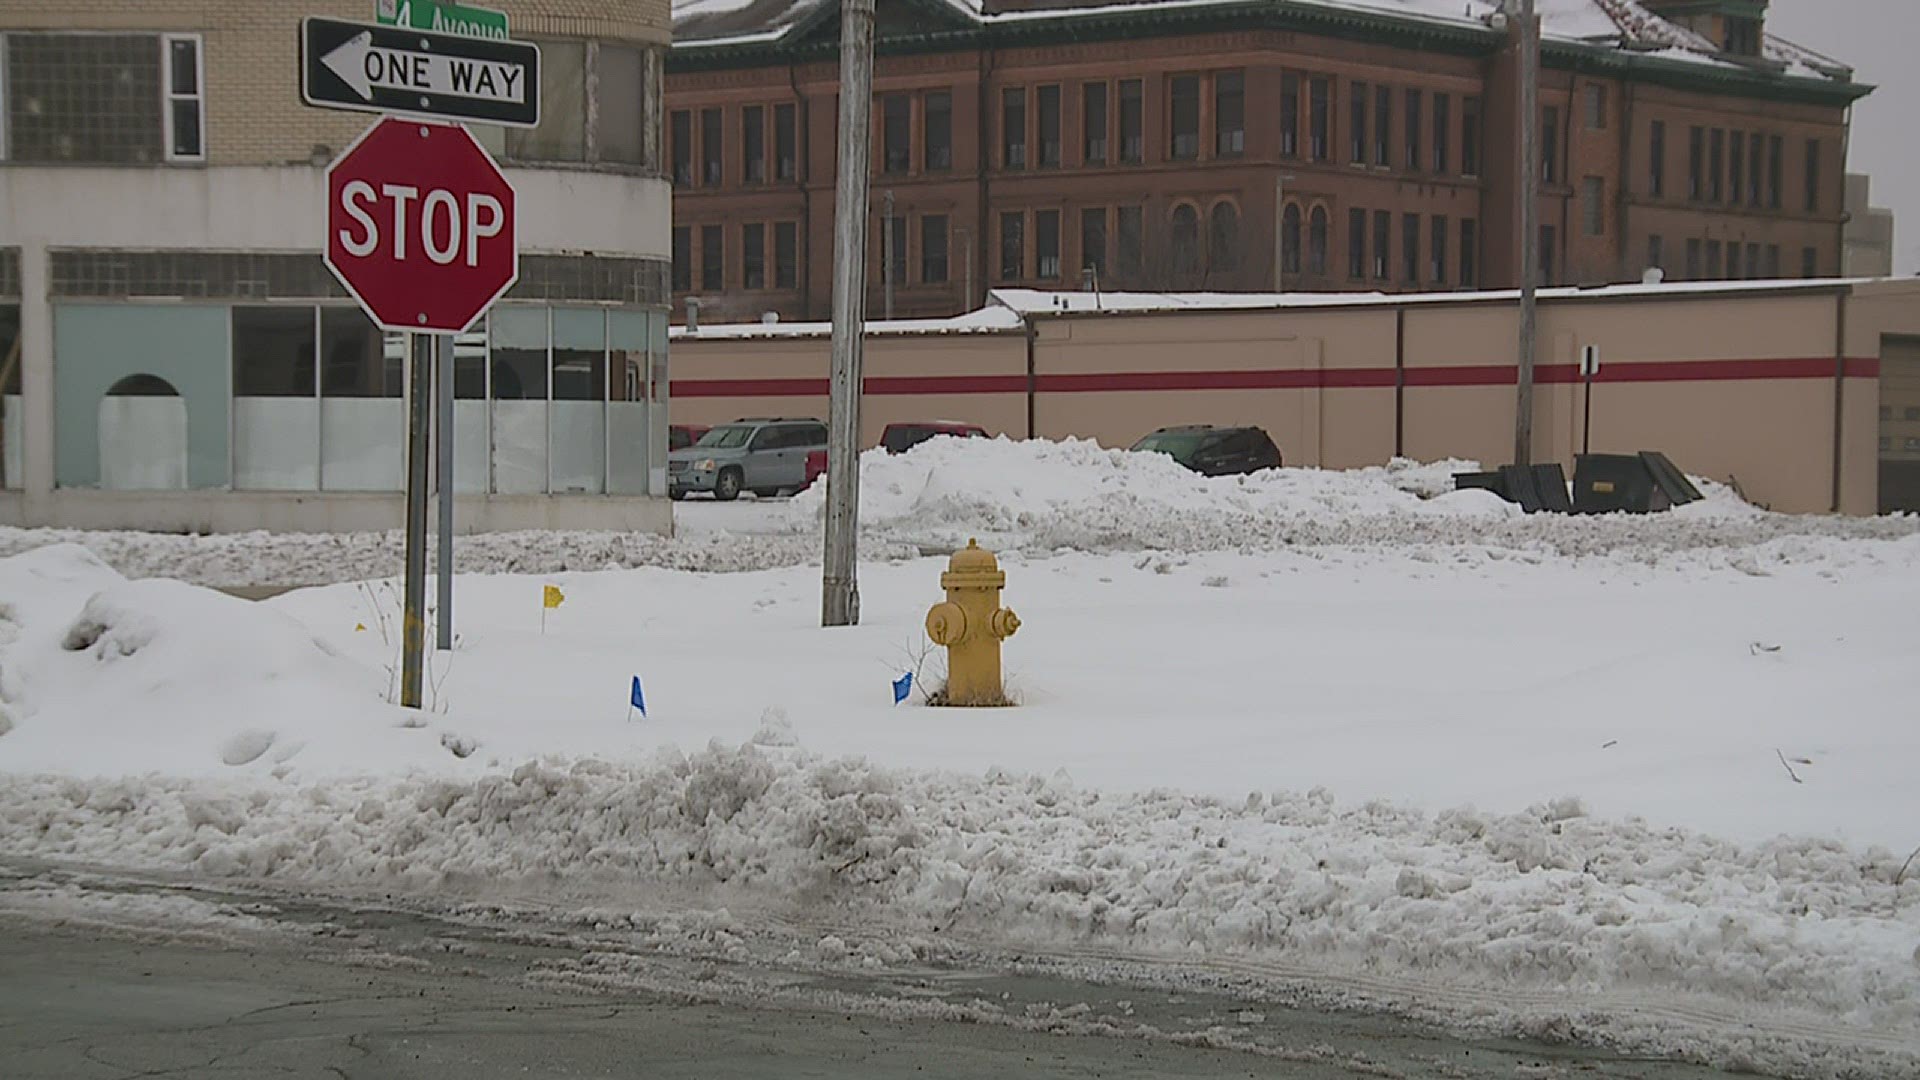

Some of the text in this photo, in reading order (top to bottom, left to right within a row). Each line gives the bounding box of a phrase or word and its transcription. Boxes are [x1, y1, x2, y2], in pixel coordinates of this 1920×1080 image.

[364, 51, 520, 98] ONE WAY
[339, 179, 505, 267] STOP
